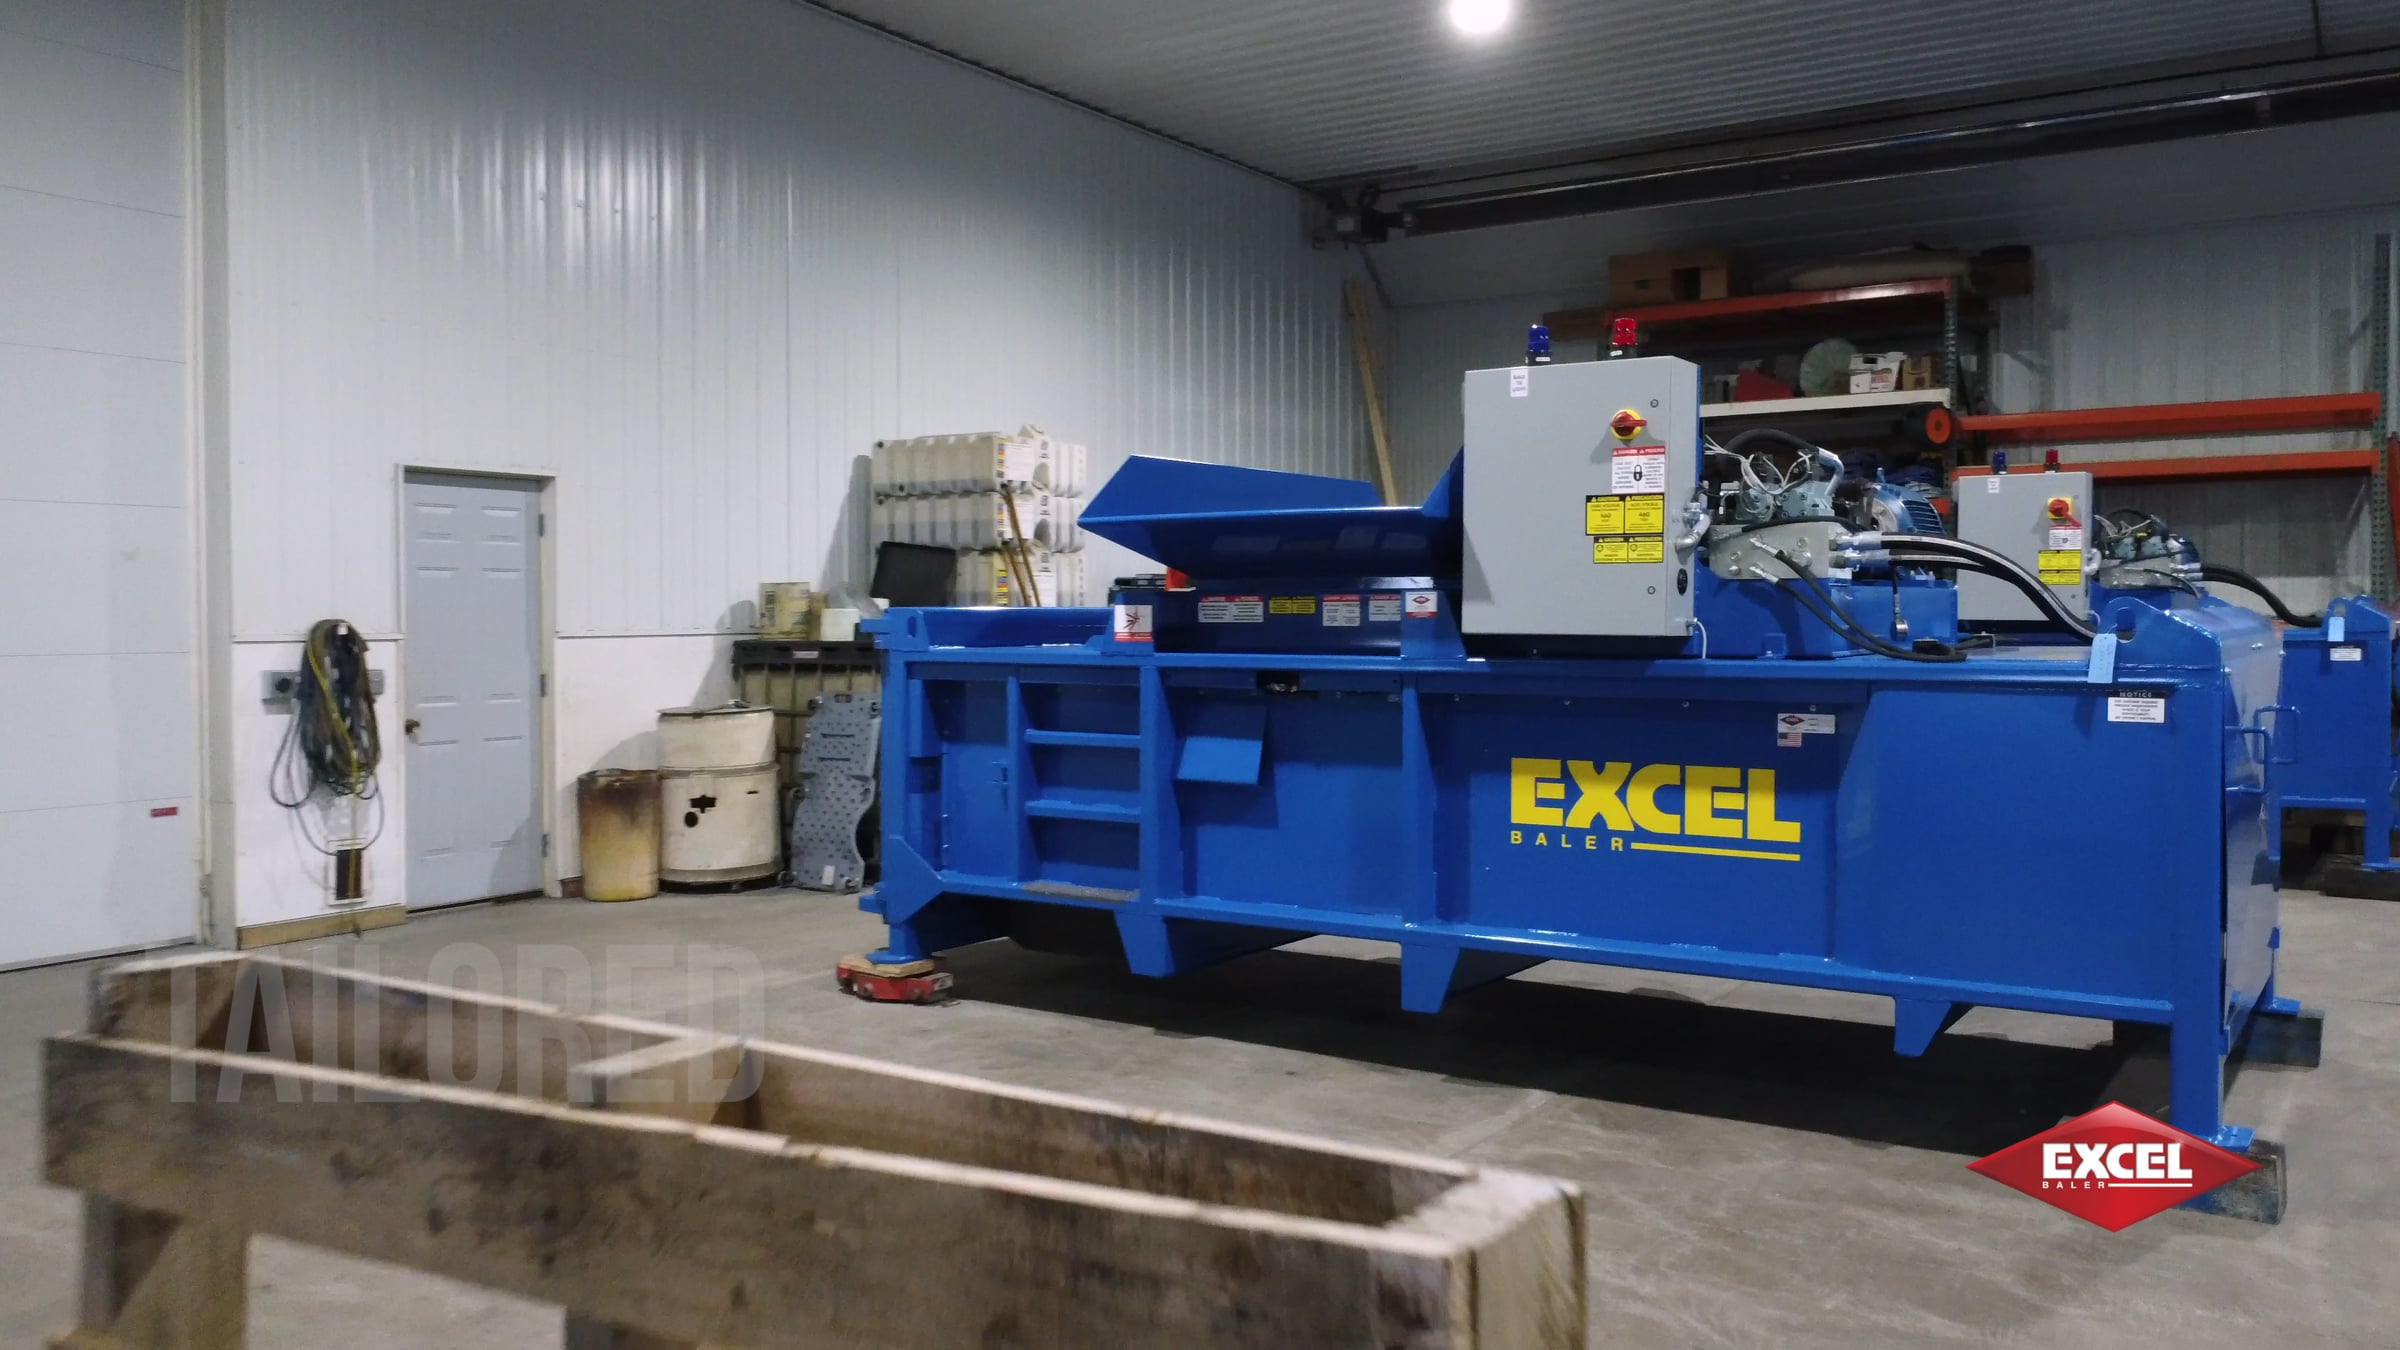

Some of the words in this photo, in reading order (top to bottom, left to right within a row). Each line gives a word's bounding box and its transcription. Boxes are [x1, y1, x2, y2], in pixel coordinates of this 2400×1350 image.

[2119, 691, 2153, 699] NOTICE
[1510, 757, 1801, 843] EXCEL
[1510, 830, 1624, 852] BALER
